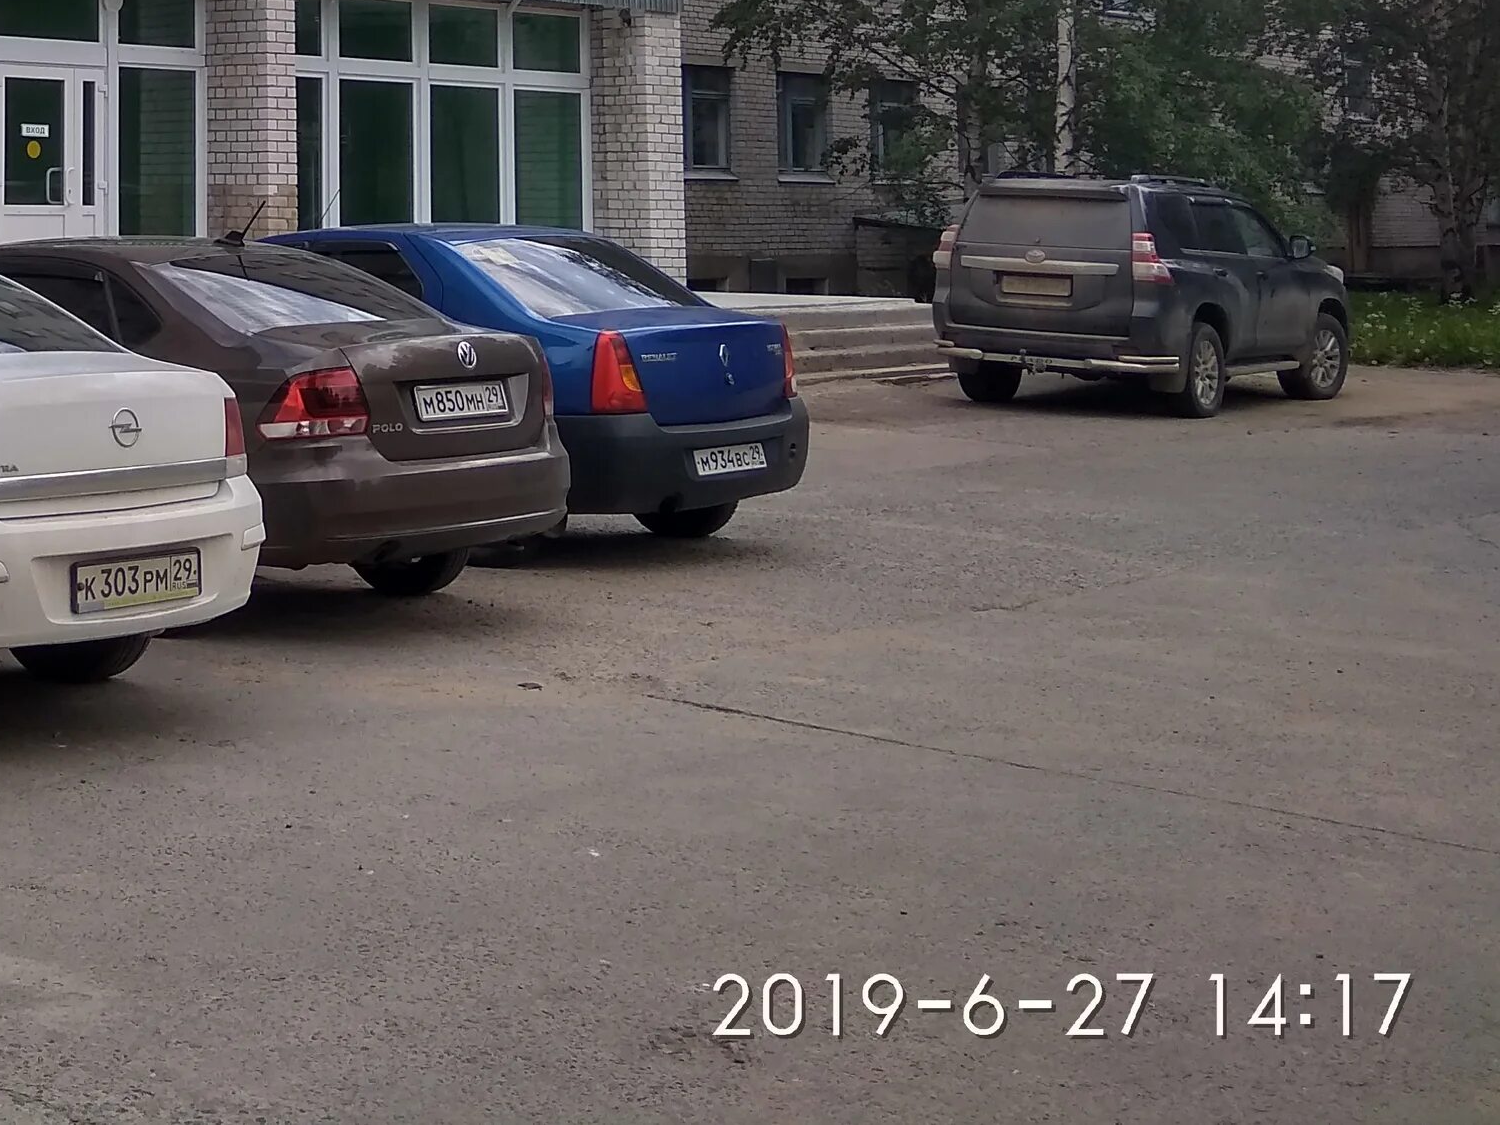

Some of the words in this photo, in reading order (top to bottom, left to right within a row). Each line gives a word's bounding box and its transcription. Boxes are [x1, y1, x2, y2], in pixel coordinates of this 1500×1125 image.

[25, 126, 45, 135] ВХОД
[485, 386, 499, 403] 29
[372, 423, 404, 434] POLO
[749, 444, 760, 460] 29
[173, 558, 193, 581] 29
[172, 581, 187, 589] RUS
